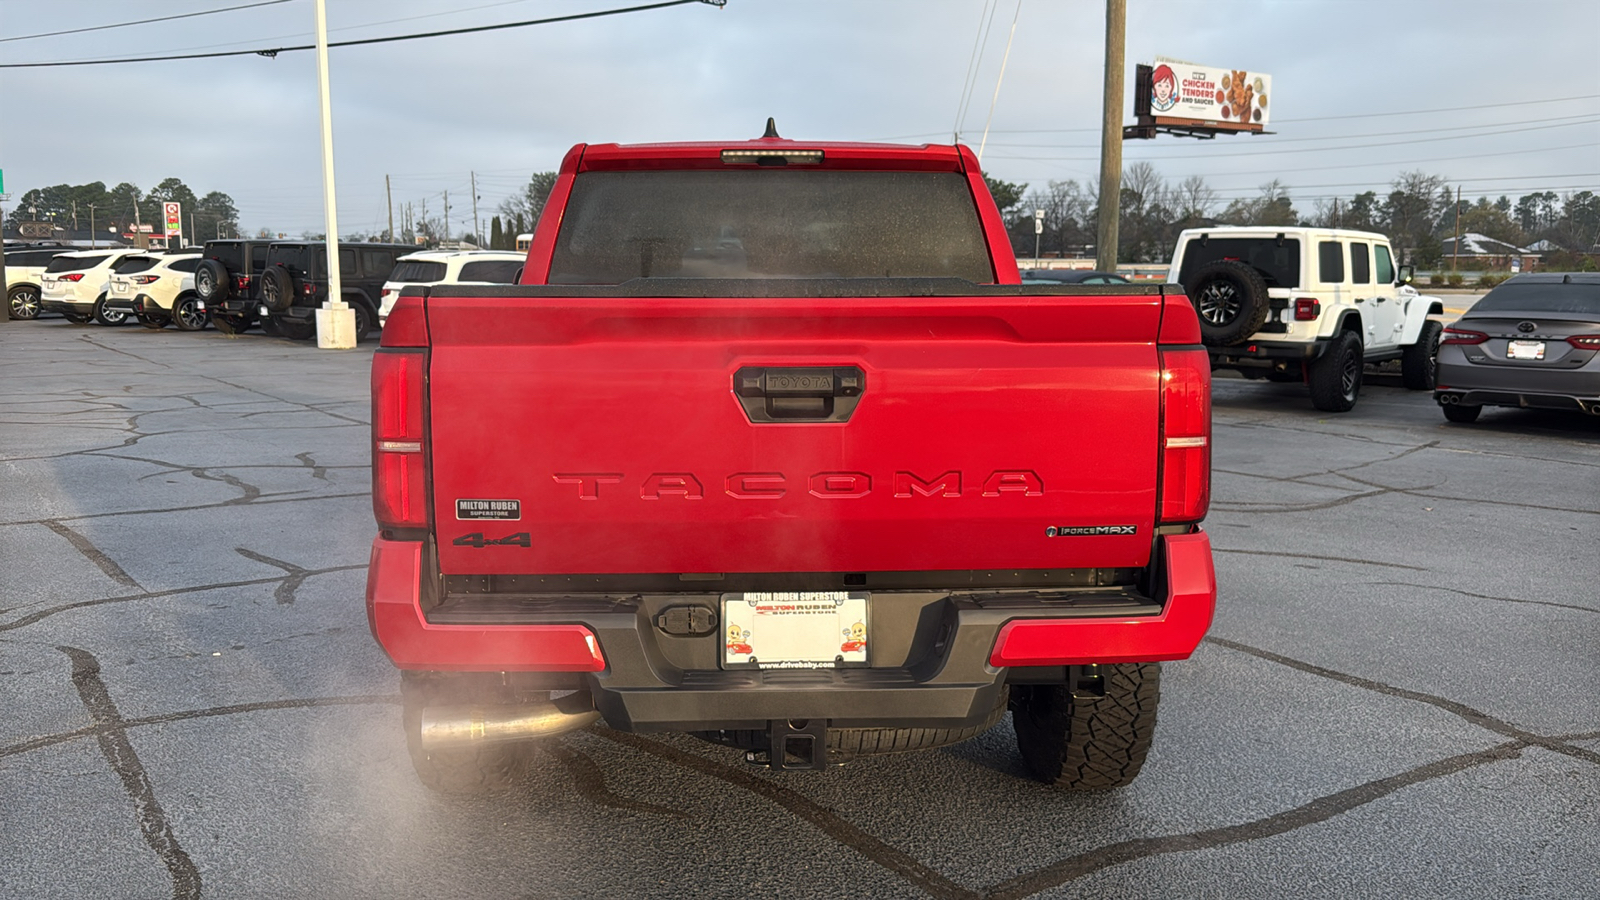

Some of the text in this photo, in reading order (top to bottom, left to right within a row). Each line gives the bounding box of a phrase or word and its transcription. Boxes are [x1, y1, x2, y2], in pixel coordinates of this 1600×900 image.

[1182, 79, 1214, 89] CHICKEN
[1182, 88, 1214, 98] TENDERS
[770, 376, 831, 388] TOYOTA
[552, 469, 1045, 500] TACOMA
[460, 501, 517, 510] MILTON RUBEN
[744, 592, 849, 601] MILTON RUBEN SUPERSTORE
[759, 660, 835, 669] www.drivebaby.com
